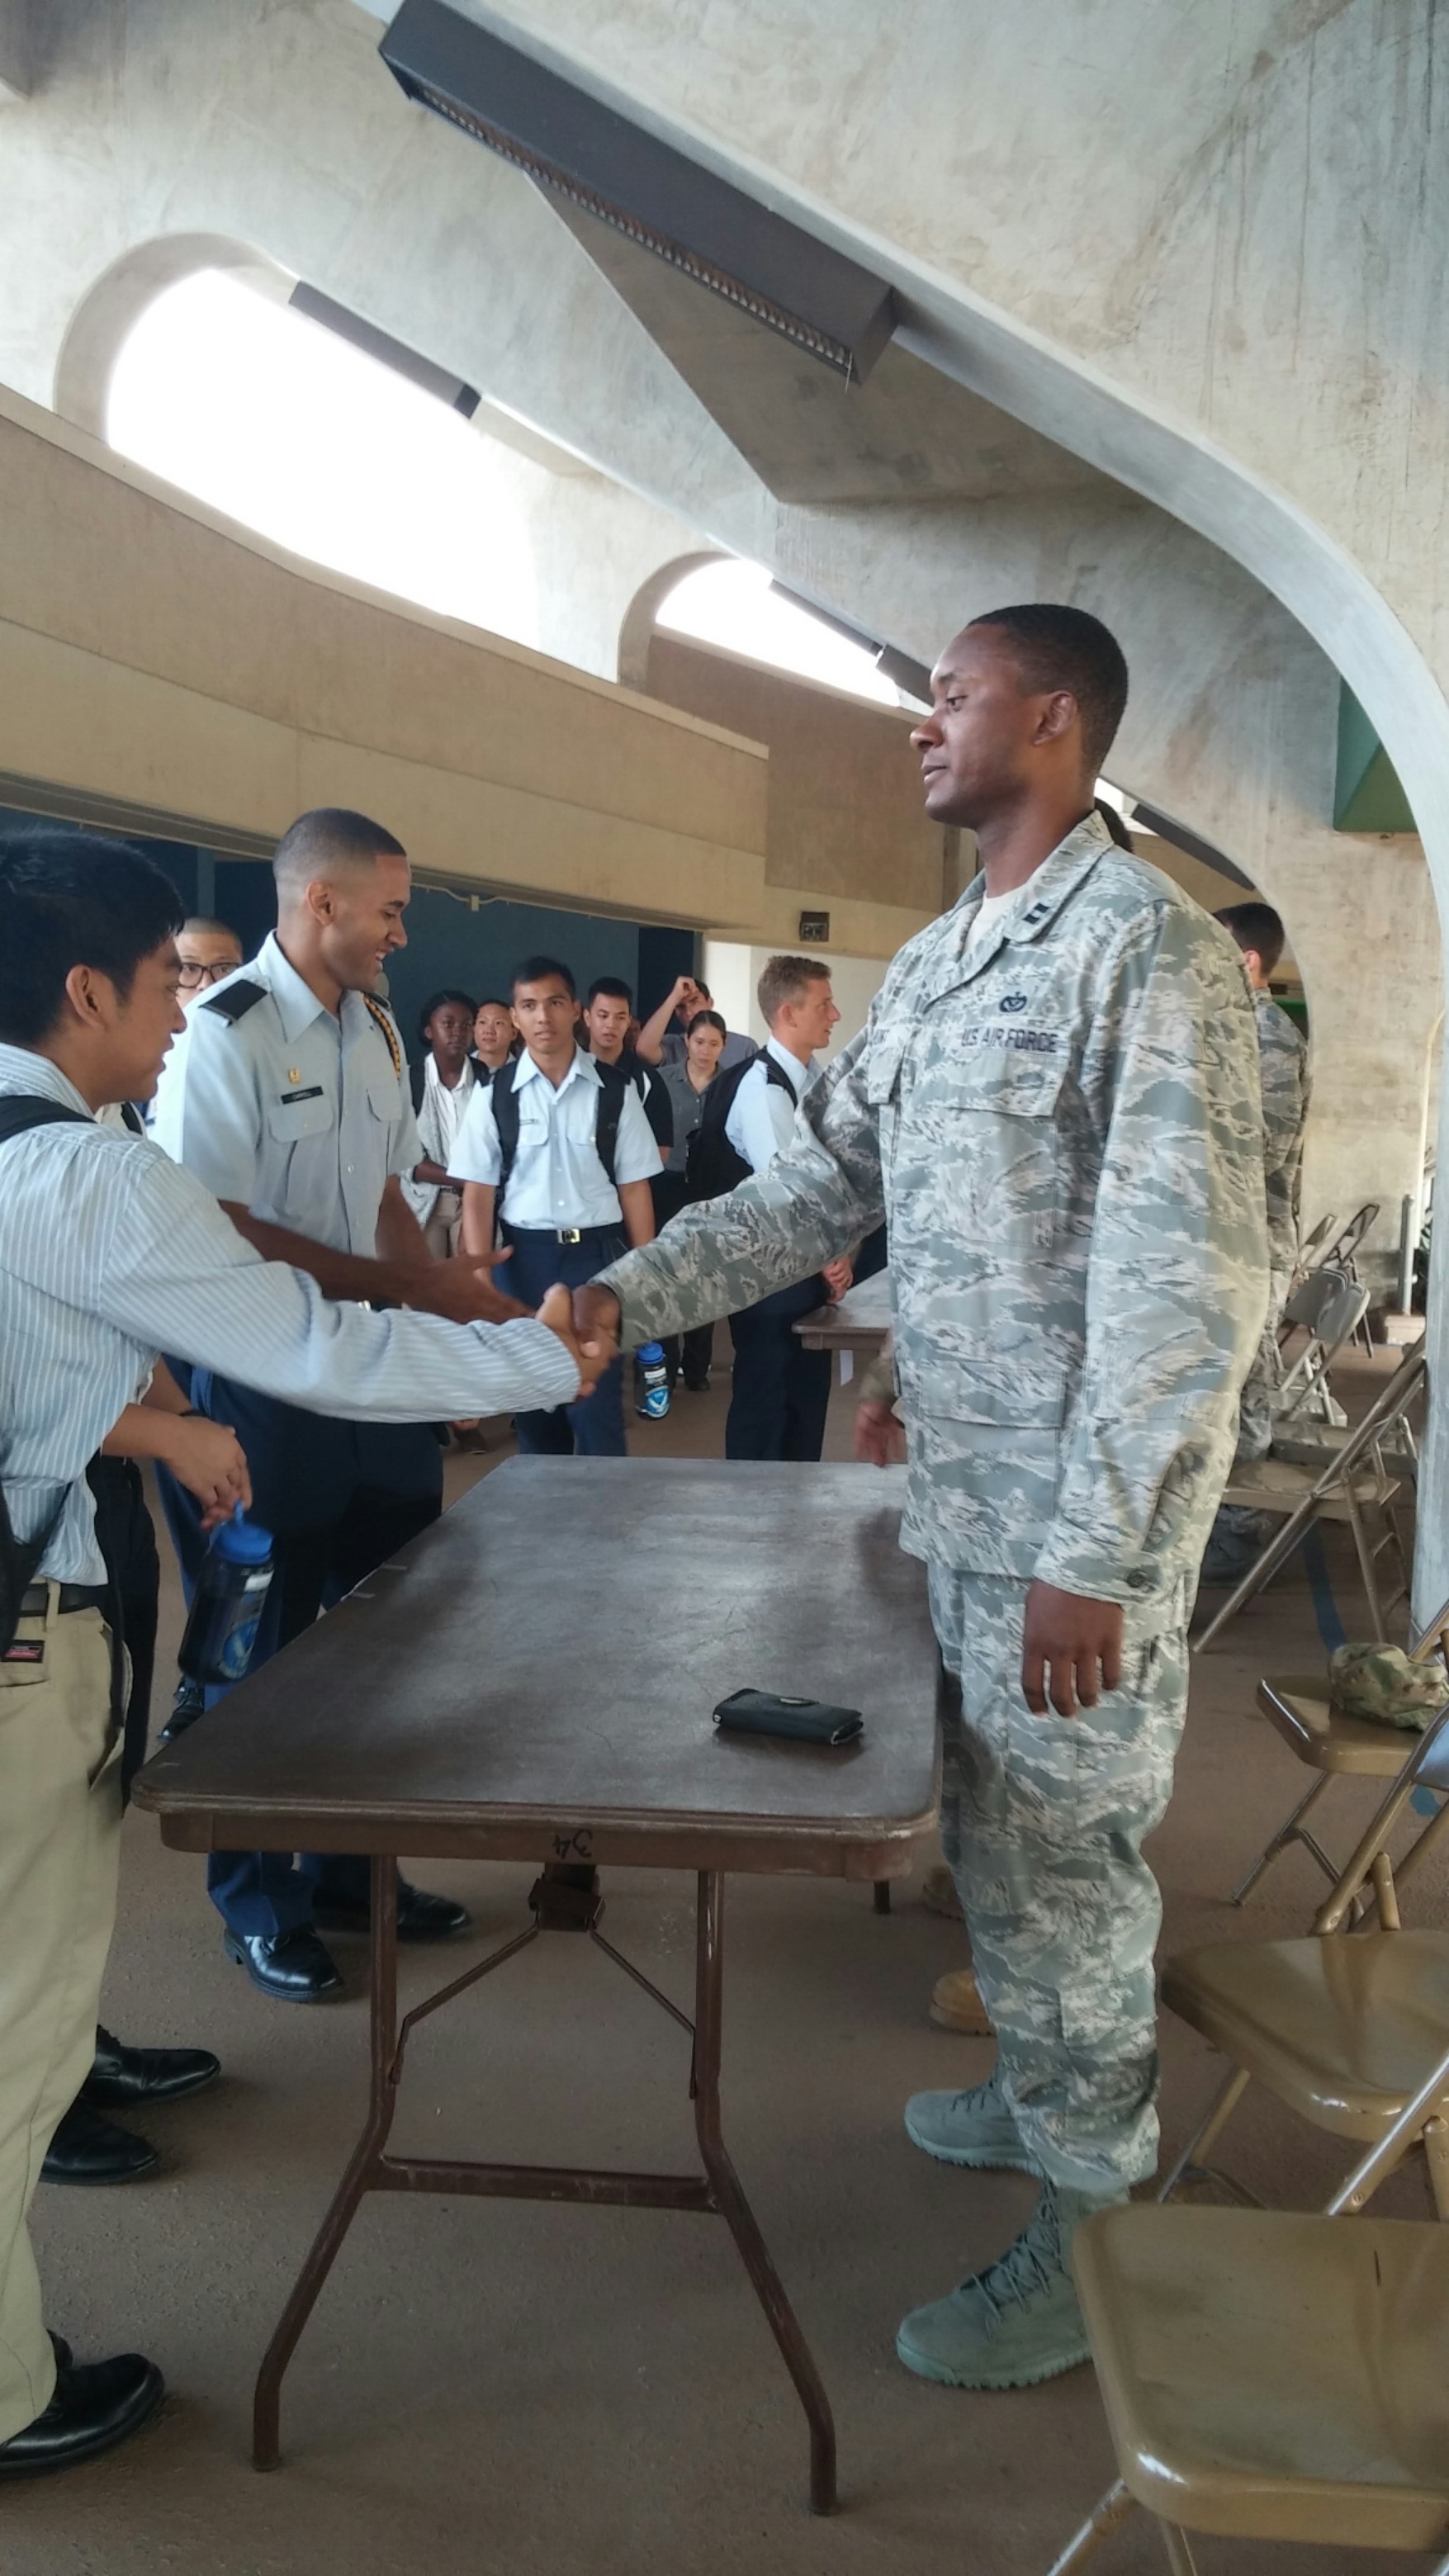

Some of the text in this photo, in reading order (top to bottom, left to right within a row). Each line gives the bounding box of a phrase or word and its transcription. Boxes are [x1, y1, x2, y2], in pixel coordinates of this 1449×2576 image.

[981, 1027, 1005, 1048] AIR
[1005, 1029, 1058, 1053] FORCE
[552, 1829, 593, 1859] 34
